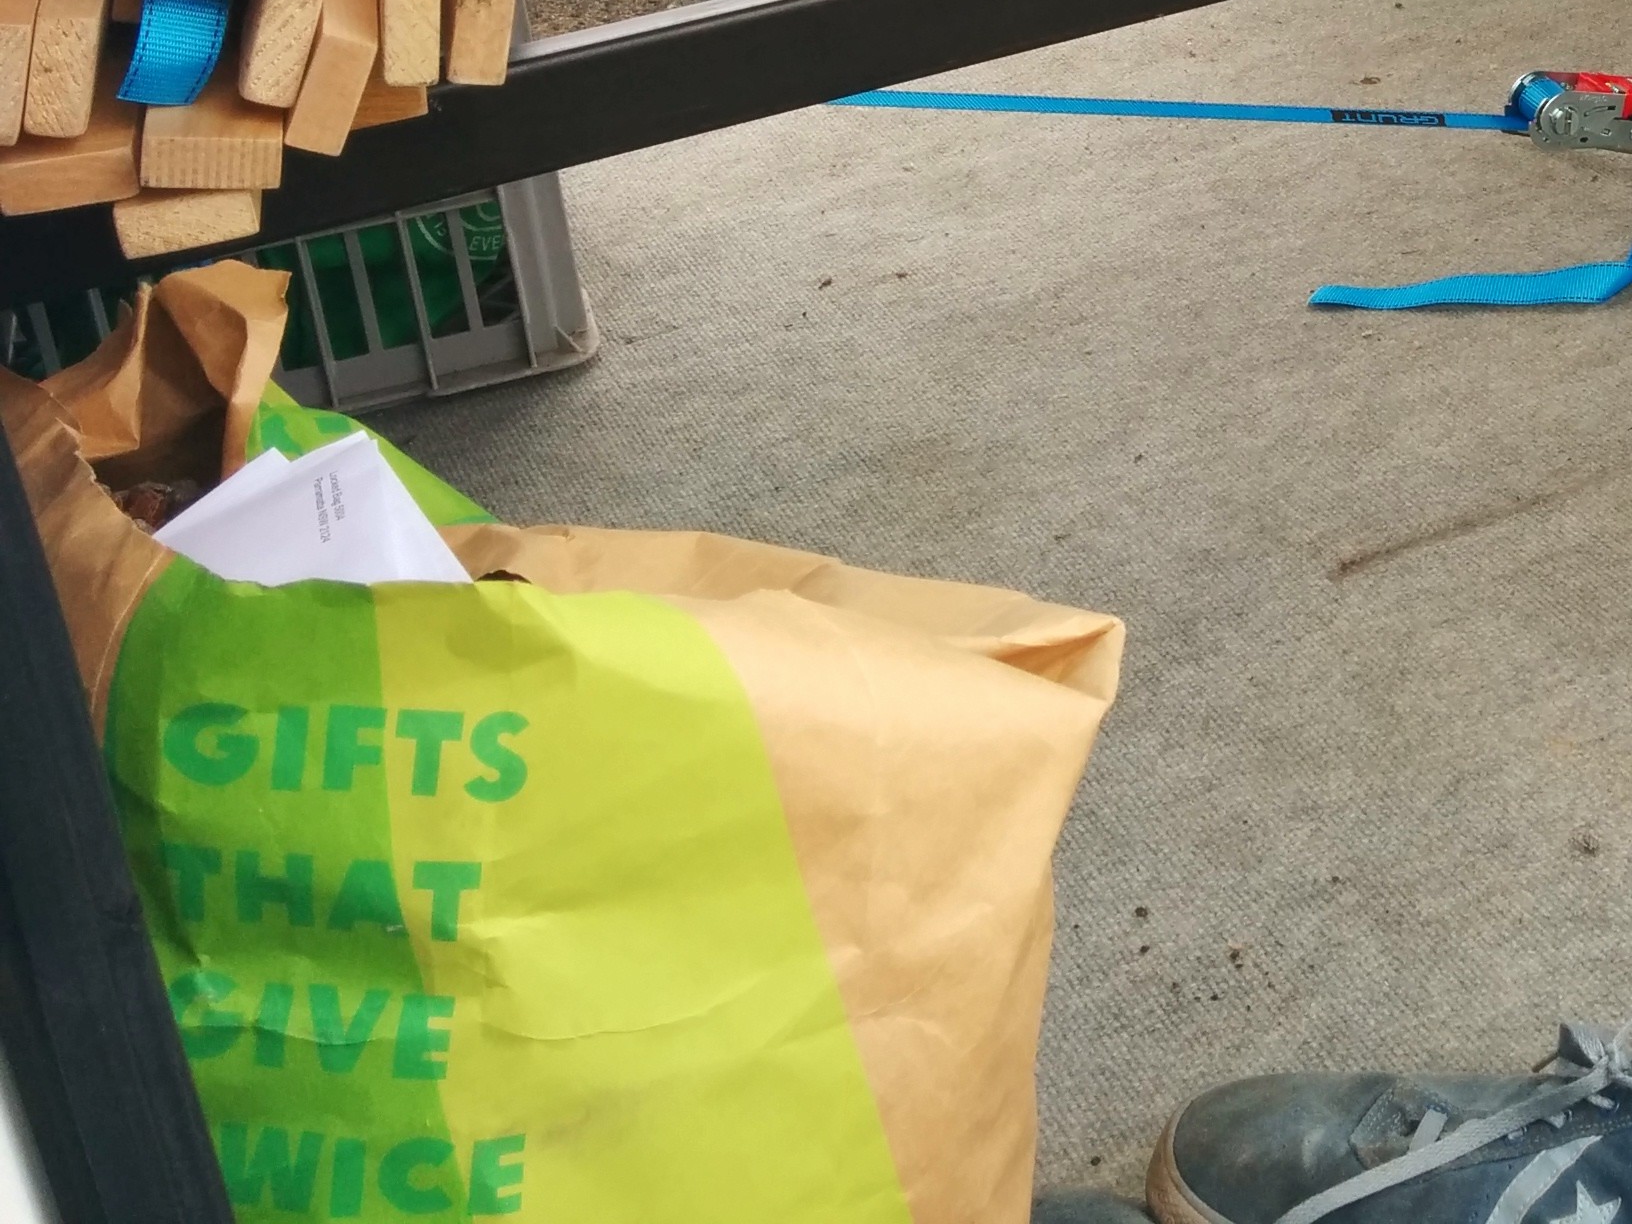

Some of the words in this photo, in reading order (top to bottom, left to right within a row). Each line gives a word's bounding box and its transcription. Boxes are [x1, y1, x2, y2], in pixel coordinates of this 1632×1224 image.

[1341, 113, 1439, 125] GRUNT
[331, 491, 343, 507] Bag
[163, 702, 530, 802] GIFTS
[162, 841, 483, 942] THAT
[168, 969, 457, 1081] GIVE
[219, 1121, 527, 1218] WICE
